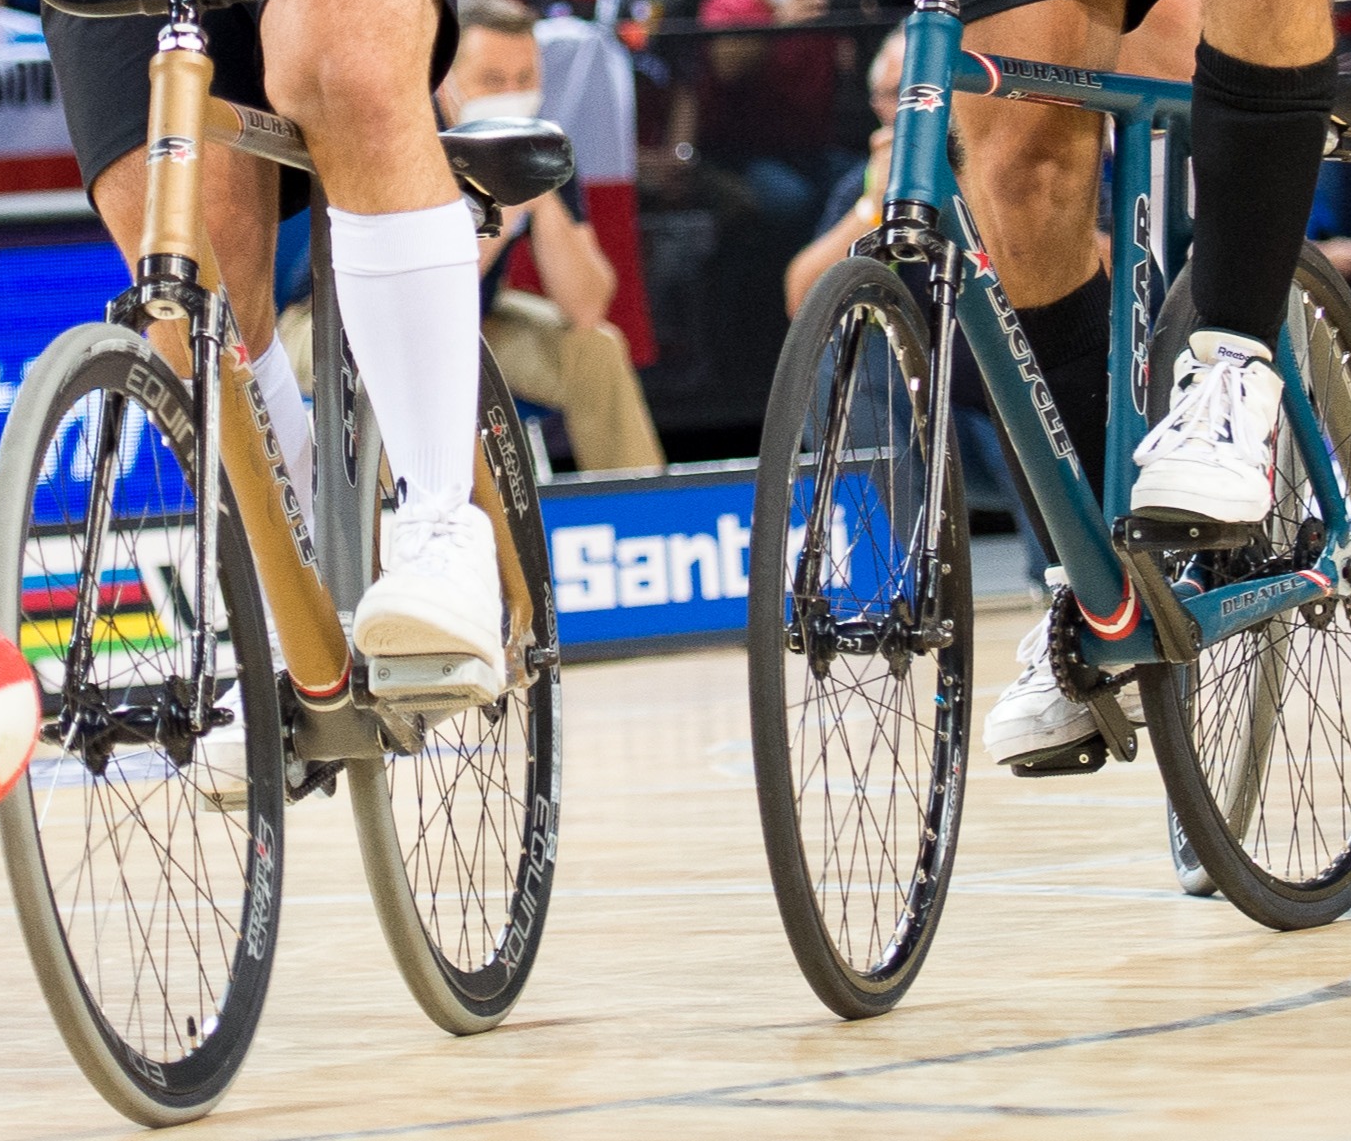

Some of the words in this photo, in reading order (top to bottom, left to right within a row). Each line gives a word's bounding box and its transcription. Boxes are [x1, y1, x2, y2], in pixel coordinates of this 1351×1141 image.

[1001, 60, 1102, 89] DURATEC
[249, 111, 297, 138] DURA
[986, 280, 1080, 480] BICYCLE
[1217, 346, 1251, 361] Reebo
[125, 363, 195, 463] EQUIN
[550, 503, 852, 614] Santni
[1220, 575, 1308, 618] DURATEC
[497, 793, 550, 981] EQUINOX
